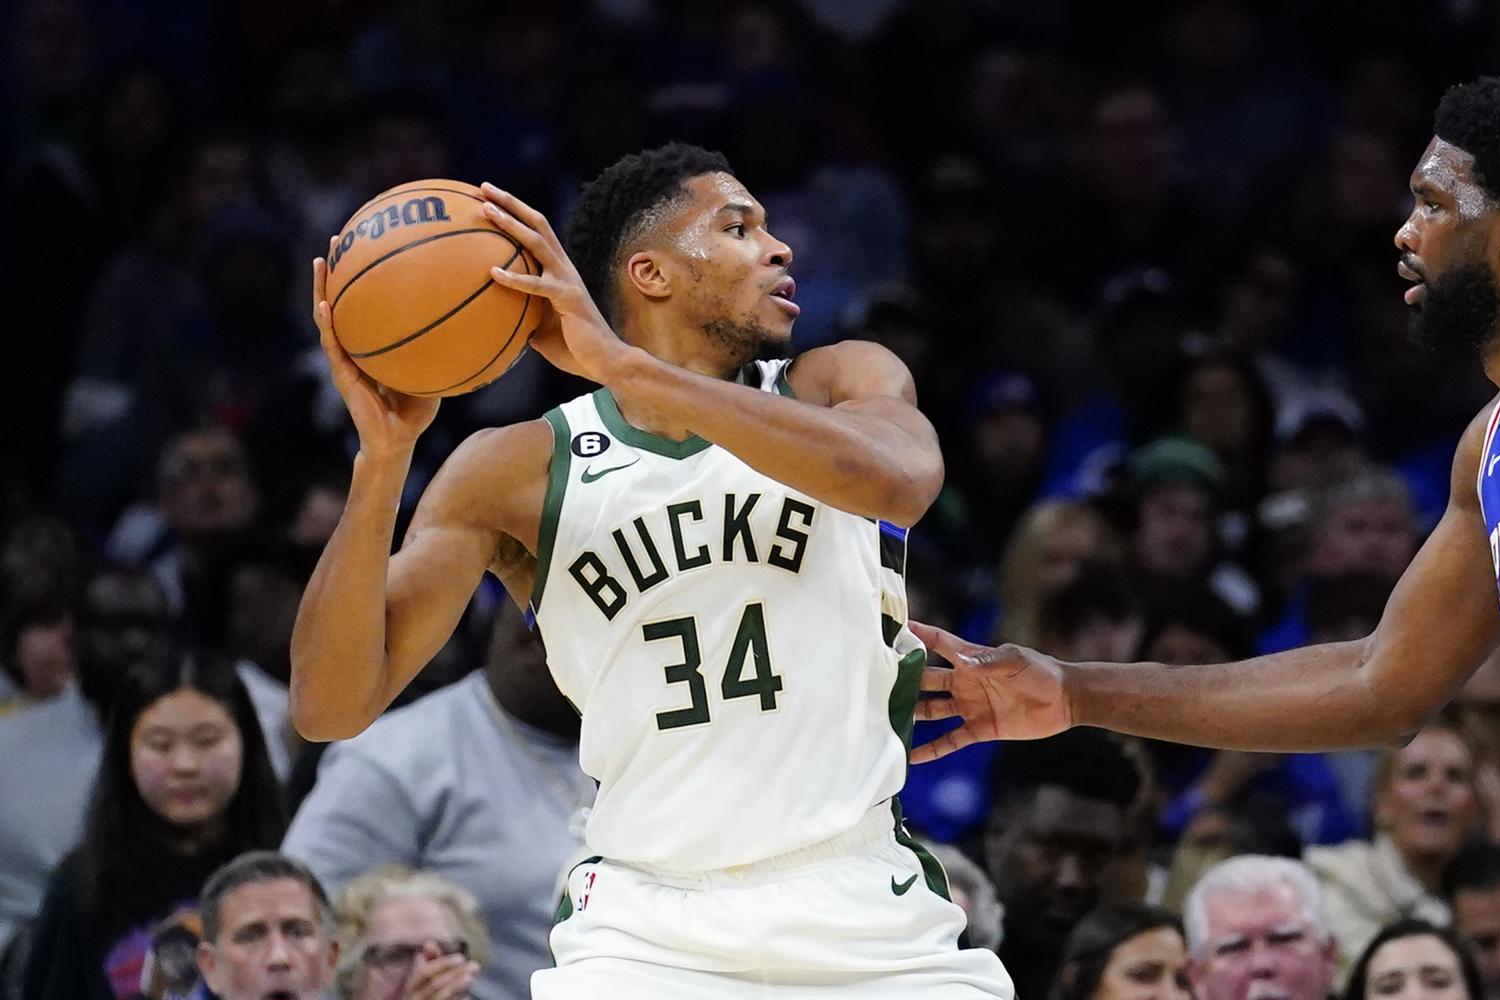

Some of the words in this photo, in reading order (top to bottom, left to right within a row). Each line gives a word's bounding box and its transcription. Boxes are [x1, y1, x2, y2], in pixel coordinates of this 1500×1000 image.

[328, 197, 451, 274] Wilson
[577, 431, 604, 456] 6
[567, 493, 817, 622] BUCKS
[641, 601, 784, 732] 34
